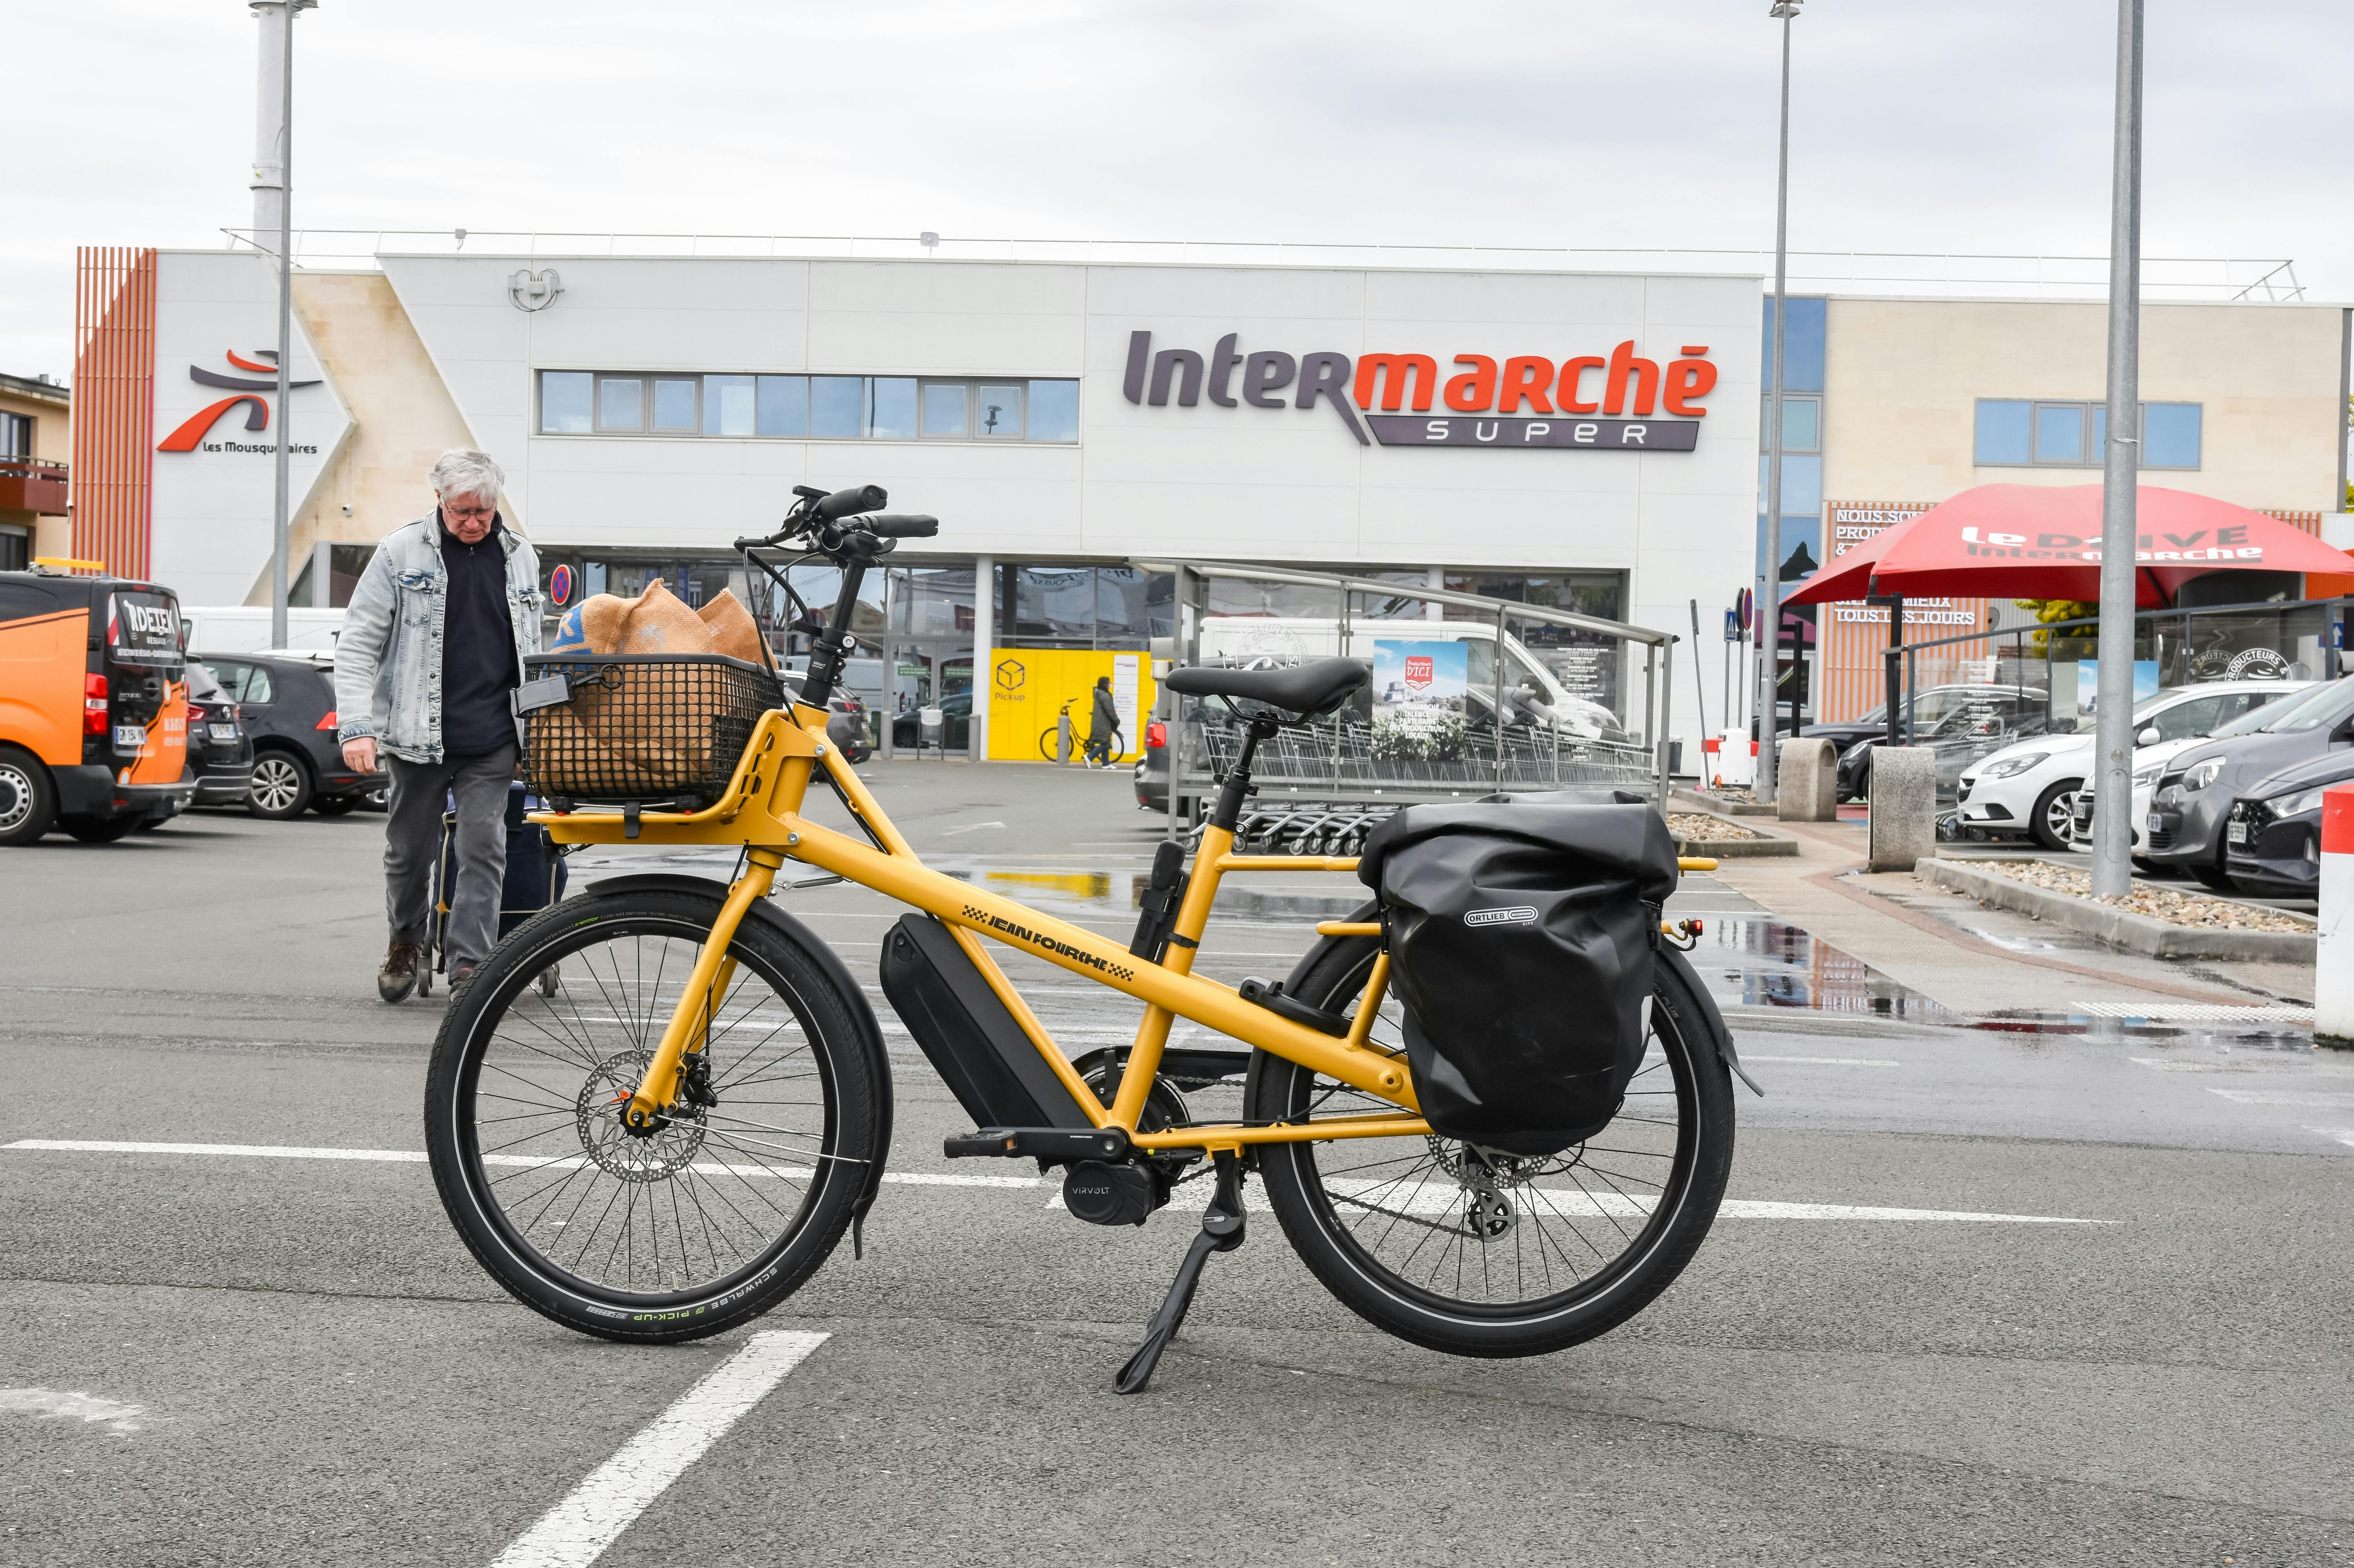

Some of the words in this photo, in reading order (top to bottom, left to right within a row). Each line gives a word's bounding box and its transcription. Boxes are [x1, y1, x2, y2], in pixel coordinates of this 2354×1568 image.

[1427, 421, 1647, 444] SUPER
[225, 442, 317, 455] Mousquaires
[1837, 510, 1883, 523] NOUS
[1836, 543, 1846, 555] &
[1834, 608, 1878, 622] TOUS
[1884, 610, 1915, 623] LS
[1919, 611, 1975, 625] JOURS
[1407, 666, 1430, 677] D'ICI
[995, 693, 1025, 702] Pickup
[1469, 912, 1505, 922] ORTLIEB
[988, 915, 1033, 942] JEAN
[1033, 934, 1108, 972] FOURCHE
[1661, 995, 1680, 1019] PLUS
[710, 1266, 778, 1309] SCHWALBE
[633, 1310, 690, 1320] PICK-UP
